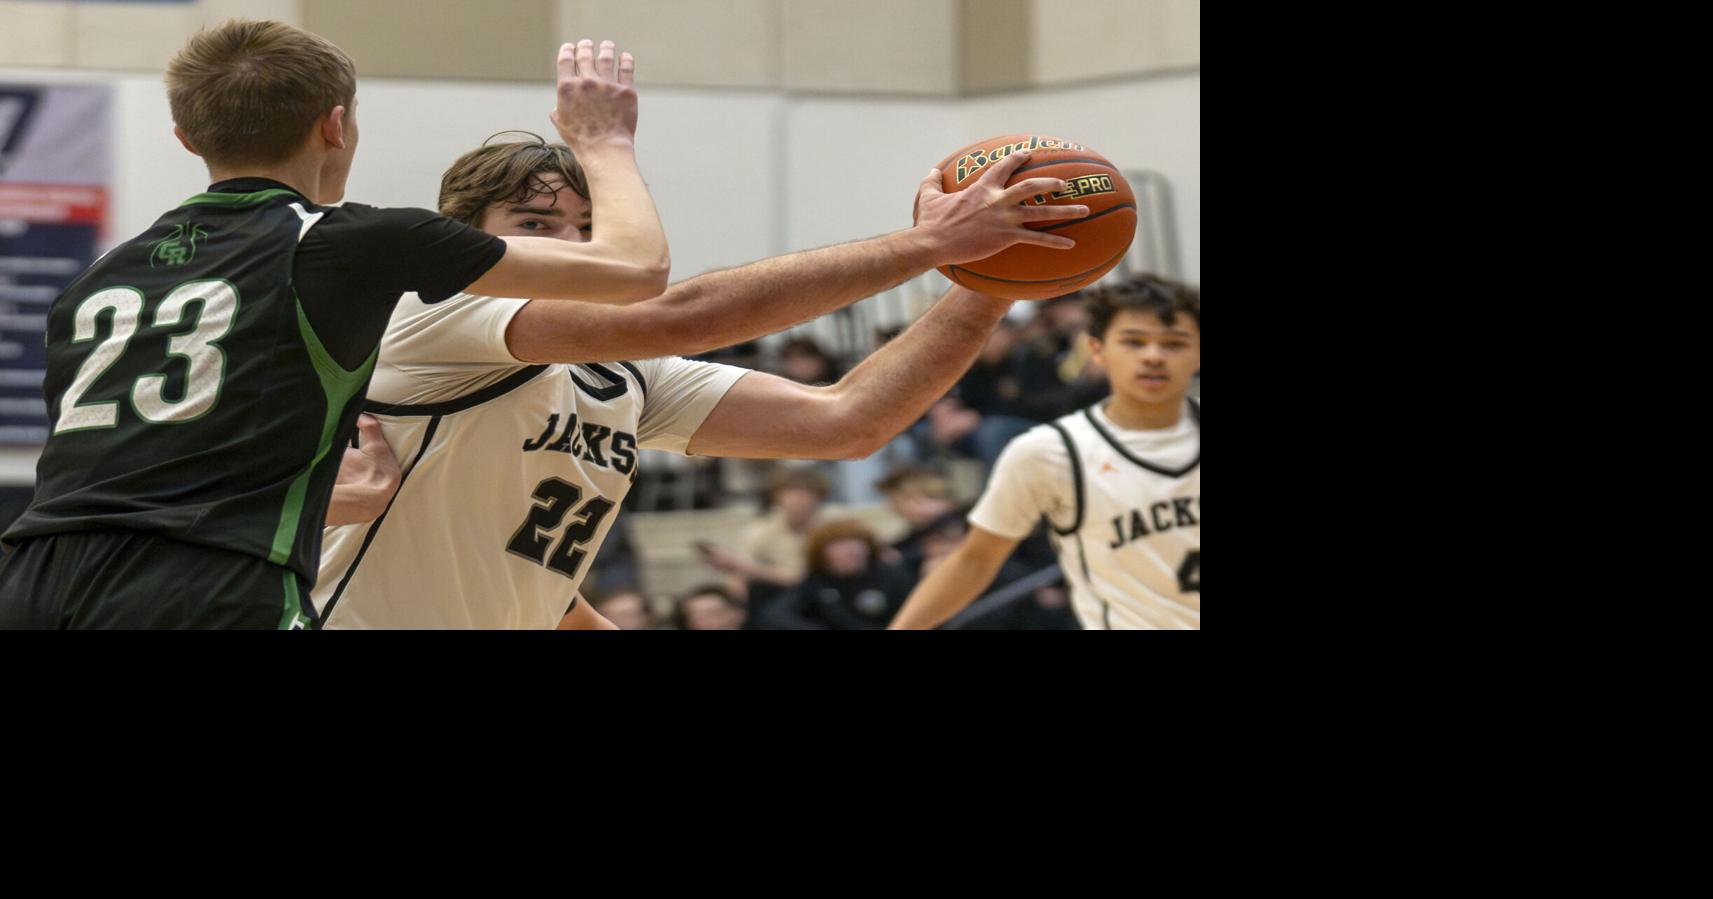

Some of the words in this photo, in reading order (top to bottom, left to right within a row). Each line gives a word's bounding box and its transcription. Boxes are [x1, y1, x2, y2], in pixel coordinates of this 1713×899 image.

[956, 135, 1084, 184] Baden
[1077, 176, 1112, 195] PRO
[53, 278, 240, 436] 23
[523, 413, 638, 484] JACKS
[505, 475, 617, 580] 22
[1109, 496, 1200, 549] JACK
